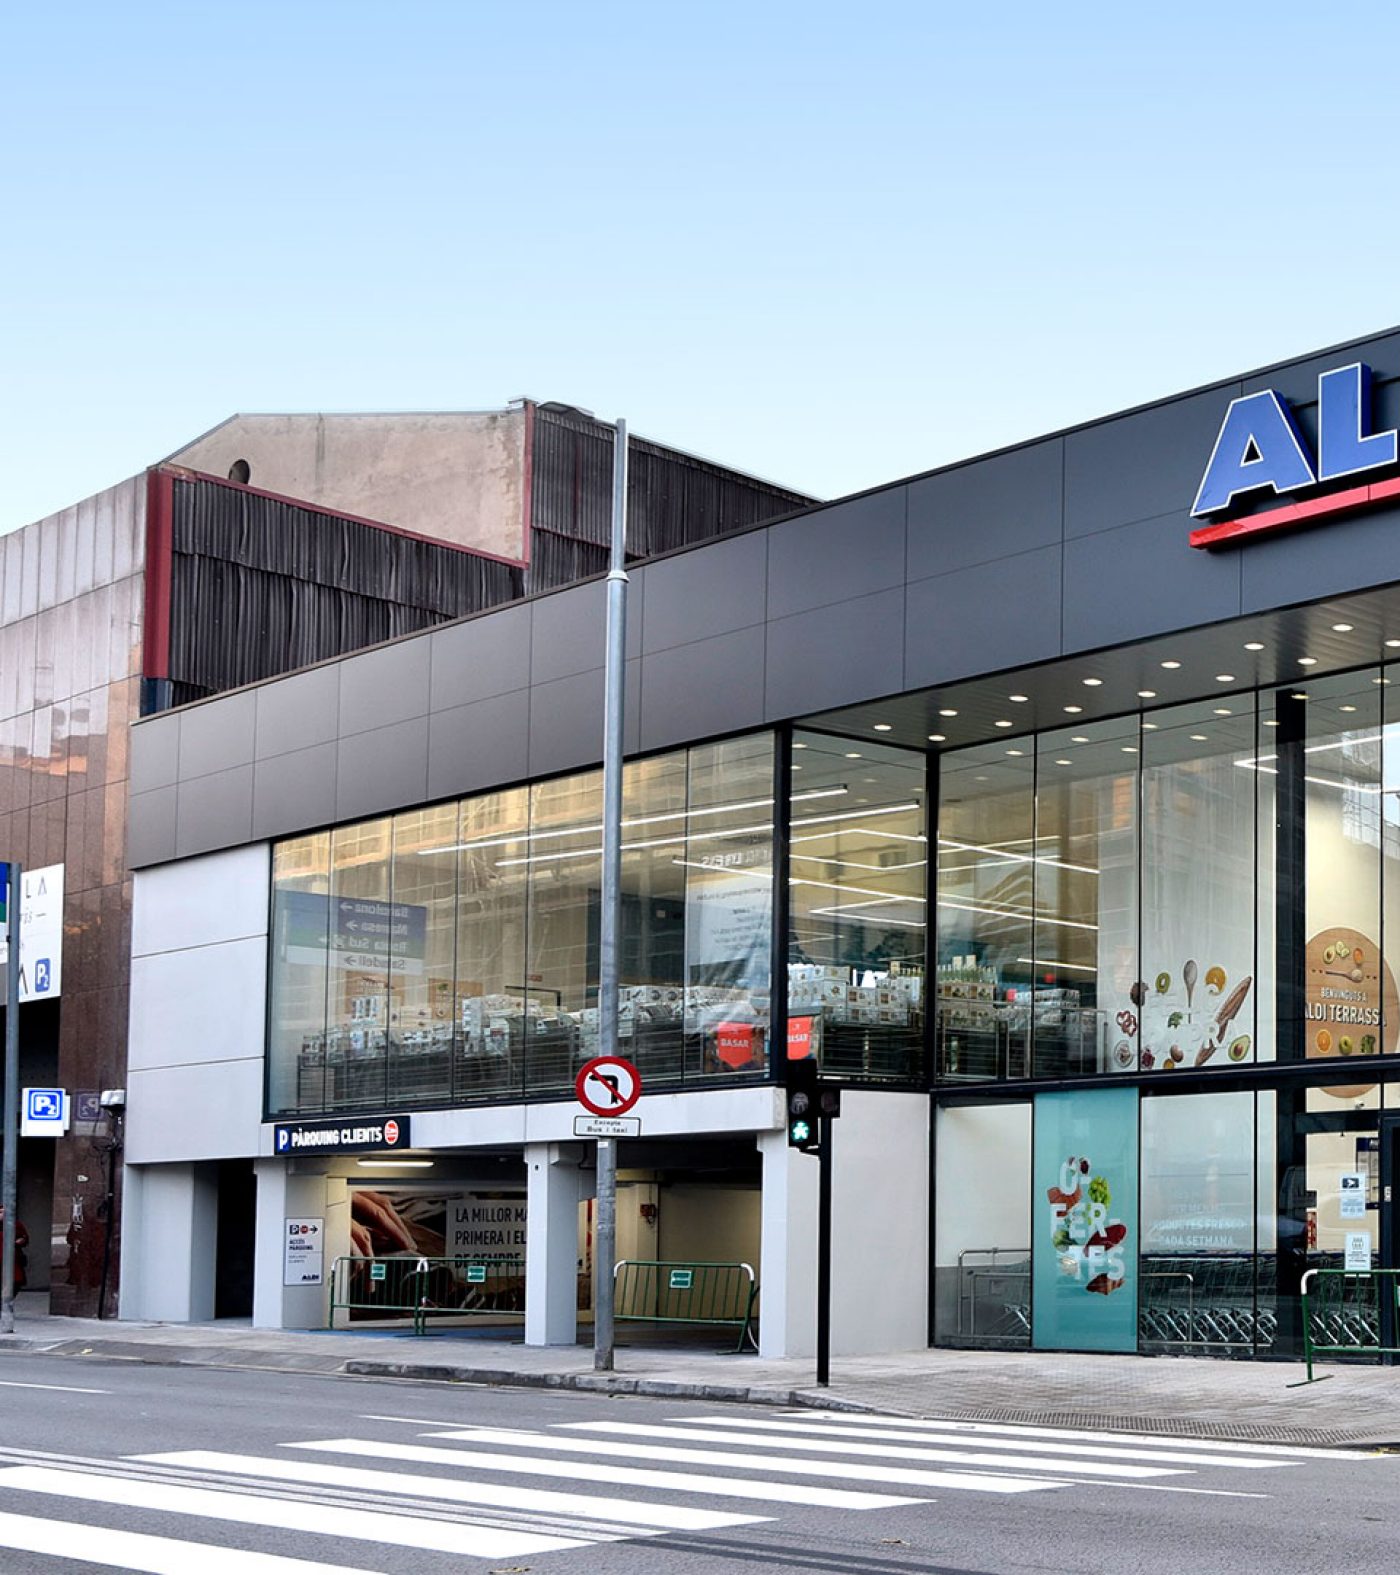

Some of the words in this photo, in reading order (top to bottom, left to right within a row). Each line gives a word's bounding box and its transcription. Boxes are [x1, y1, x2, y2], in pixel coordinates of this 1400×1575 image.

[1330, 1003, 1387, 1026] TERRASS
[341, 1126, 382, 1144] CLIENTS
[455, 1207, 469, 1223] LA
[472, 1207, 511, 1223] MILLOR
[454, 1230, 505, 1246] PRIMERA
